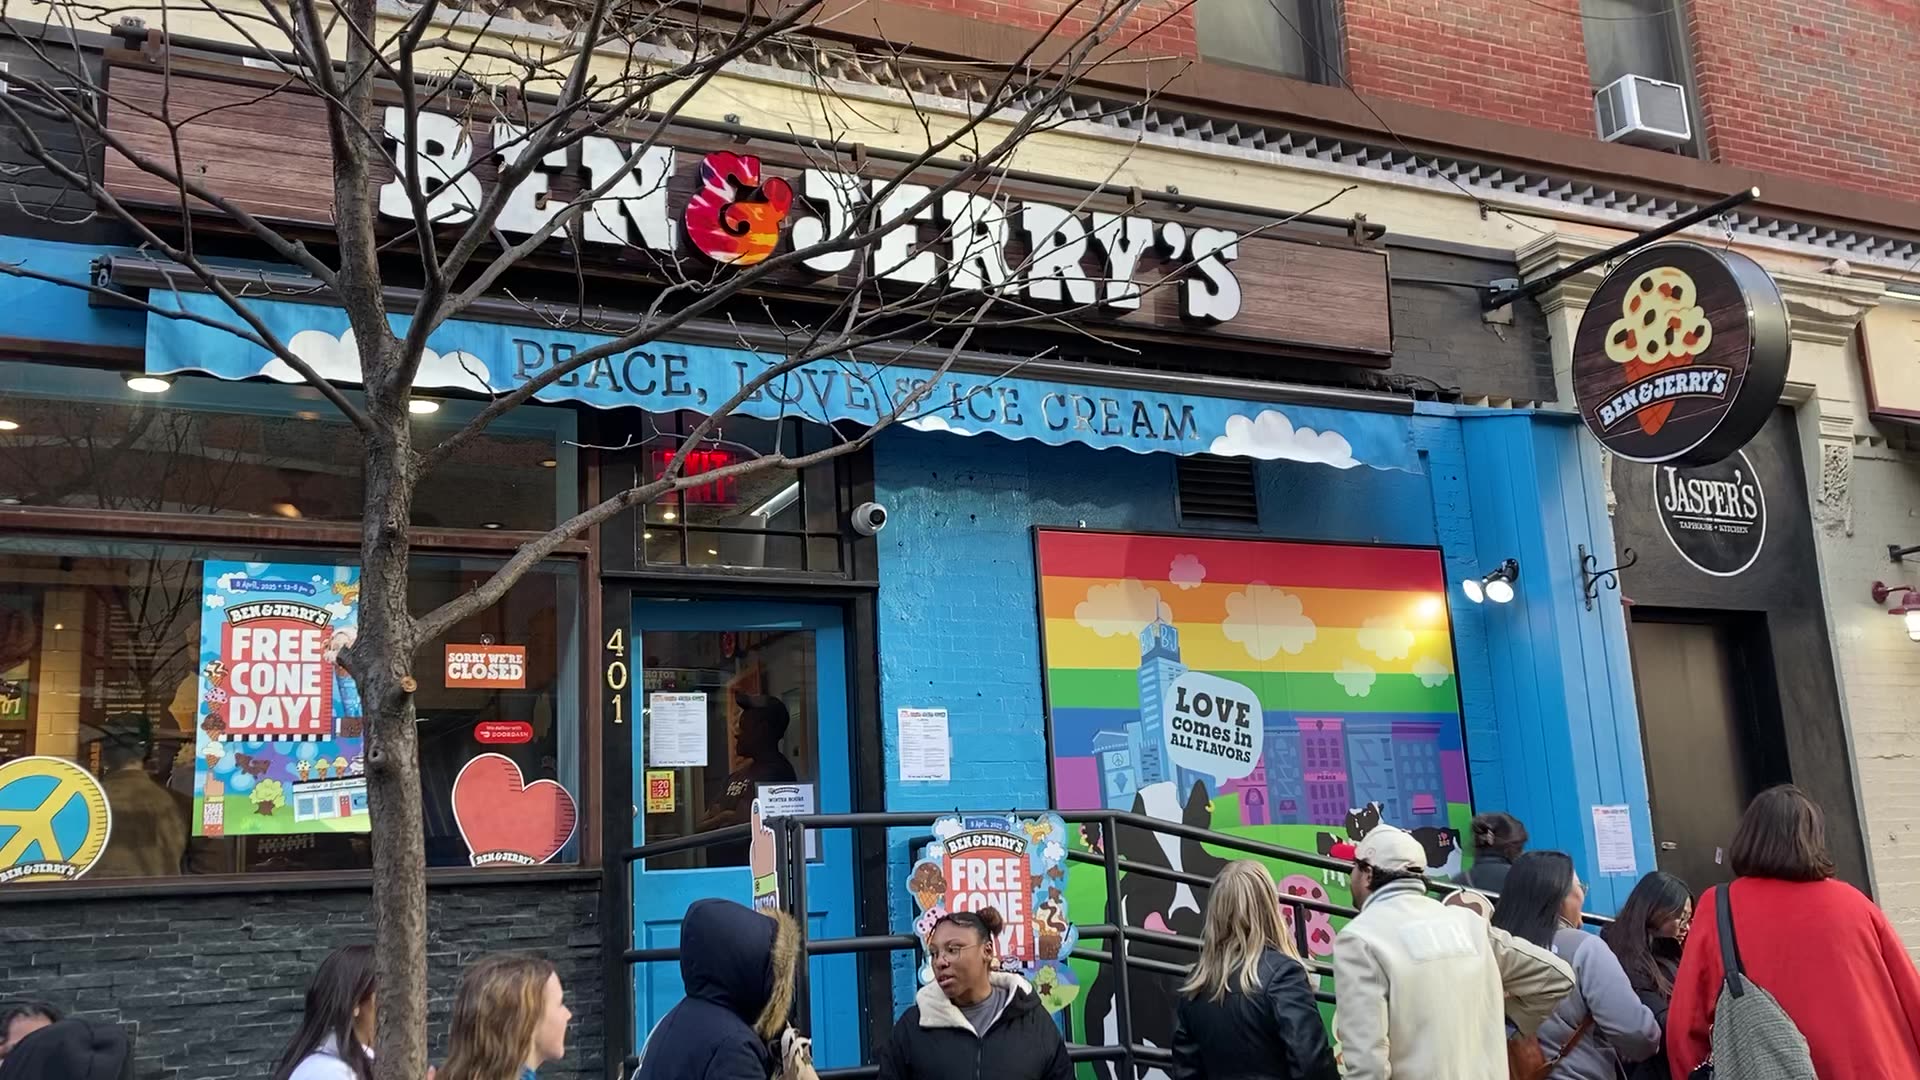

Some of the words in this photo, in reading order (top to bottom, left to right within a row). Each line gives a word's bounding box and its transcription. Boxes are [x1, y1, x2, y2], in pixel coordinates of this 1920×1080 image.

[512, 338, 707, 405] PEACE,
[732, 361, 870, 411] LOVE
[946, 381, 1023, 426] ICE
[1040, 392, 1200, 442] CREAM
[1664, 465, 1758, 519] JASPER'S
[231, 627, 322, 662] FREE
[448, 652, 486, 664] SORRY
[487, 653, 523, 665] WE'RE
[230, 662, 322, 696] CONE
[448, 663, 523, 681] CLOSED
[228, 695, 322, 729] DAY!
[1175, 686, 1251, 728] LOVE
[1170, 732, 1194, 750] ALL
[1195, 738, 1251, 764] FLAVORS
[1171, 716, 1231, 743] comes
[1234, 727, 1253, 748] in
[951, 857, 1022, 892] FREE
